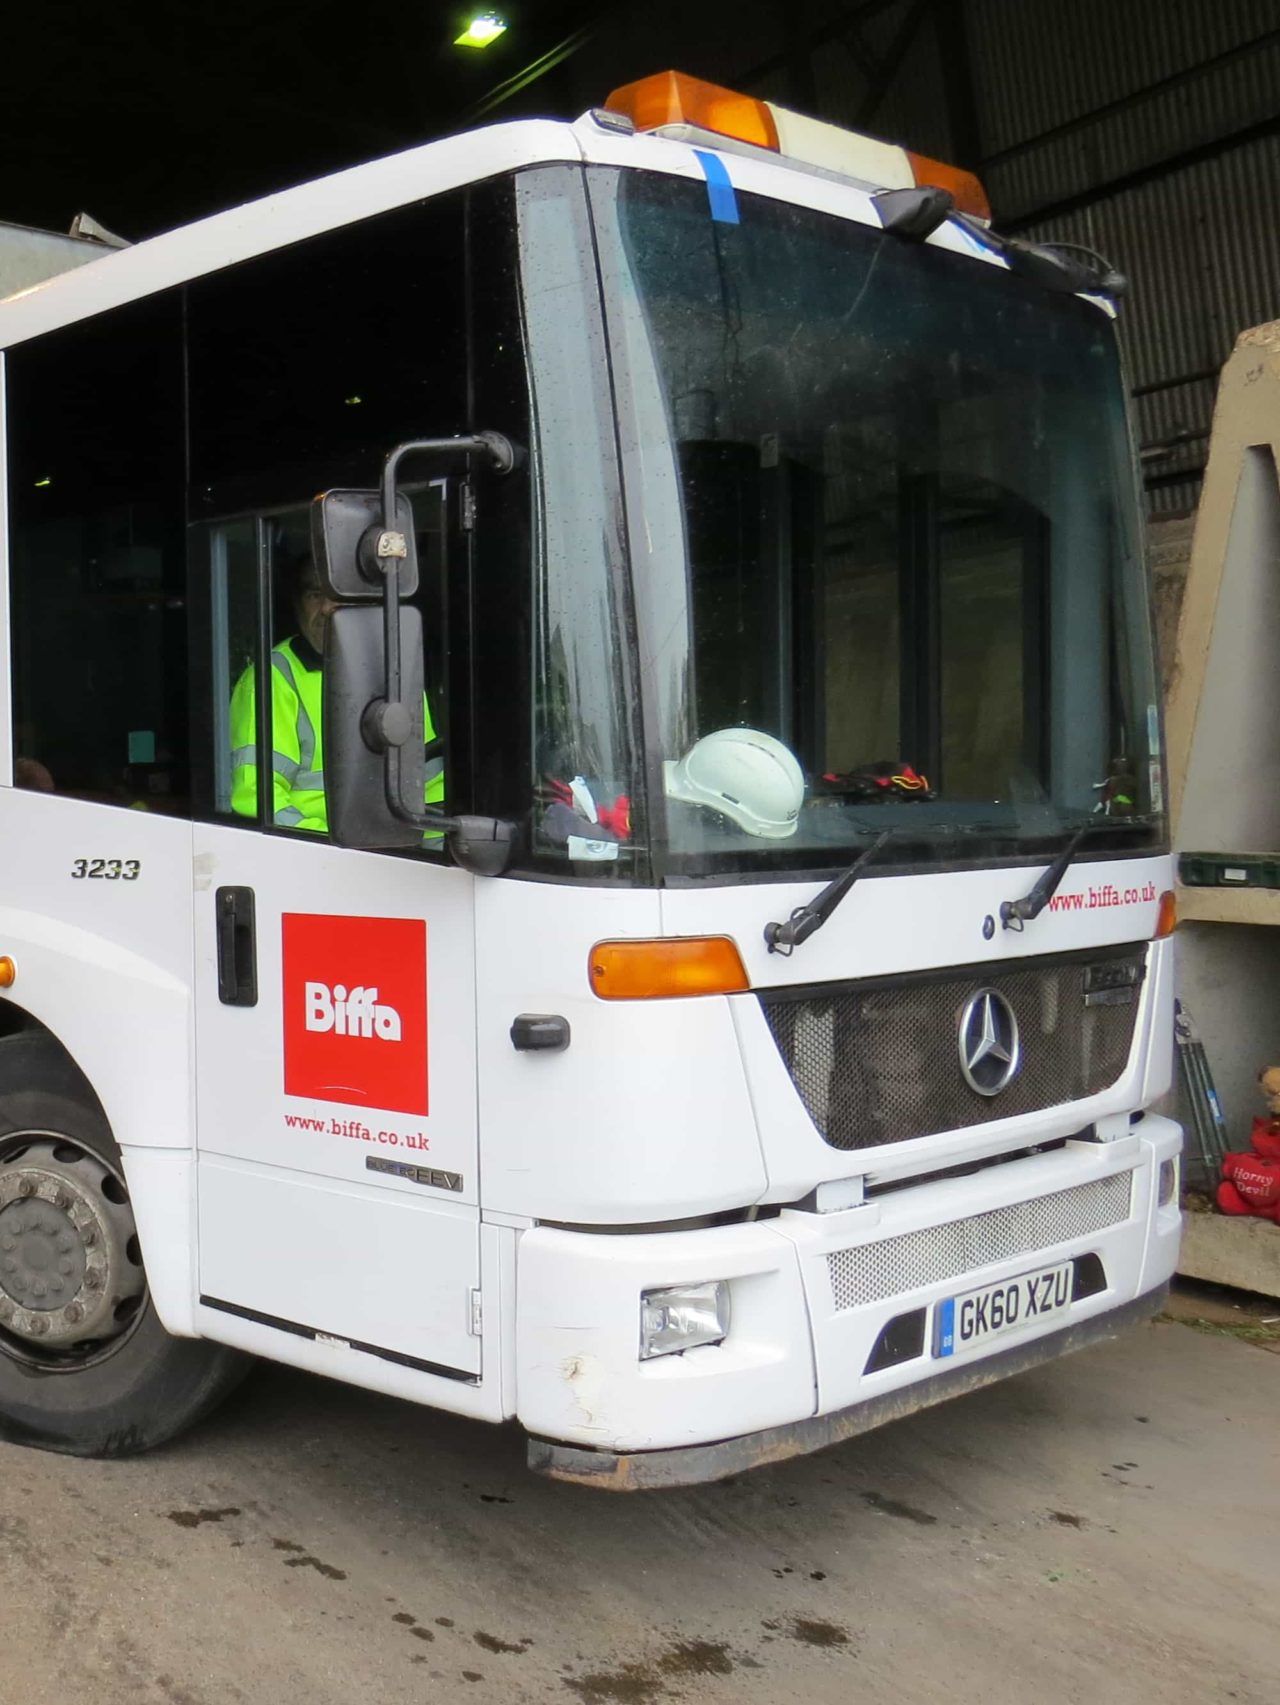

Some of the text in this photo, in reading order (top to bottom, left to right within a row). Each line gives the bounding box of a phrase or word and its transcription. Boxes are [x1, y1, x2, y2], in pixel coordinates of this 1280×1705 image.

[71, 858, 141, 881] 3233
[1049, 881, 1156, 912] www.biffa.co.uk
[305, 981, 402, 1042] Biffa
[284, 1114, 430, 1151] www.biffa.co.uk
[1233, 1167, 1274, 1187] Horny
[960, 1268, 1070, 1341] GK60 XZU
